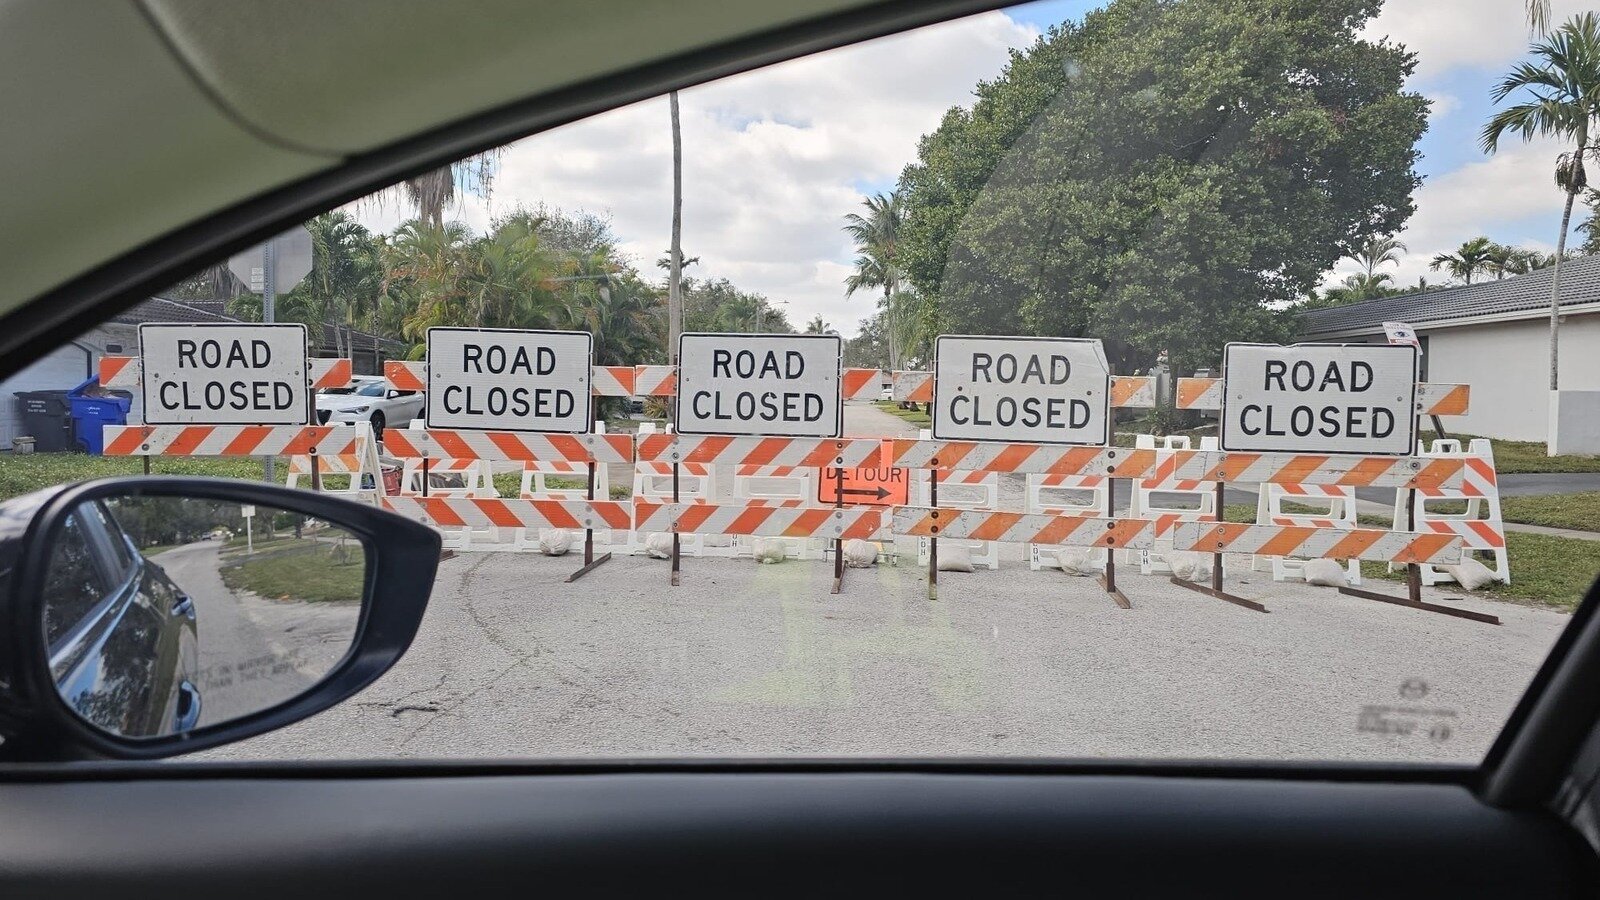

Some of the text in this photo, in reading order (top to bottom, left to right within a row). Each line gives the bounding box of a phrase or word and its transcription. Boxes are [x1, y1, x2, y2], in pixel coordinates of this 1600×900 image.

[177, 339, 272, 370] ROAD
[463, 343, 556, 377] ROAD
[713, 349, 805, 380] ROAD
[971, 352, 1072, 386] ROAD
[1264, 360, 1374, 393] ROAD
[159, 380, 294, 411] CLOSED
[443, 385, 575, 418] CLOSED
[692, 390, 824, 422] CLOSED
[949, 394, 1091, 430] CLOSED
[1239, 404, 1395, 439] CLOSED
